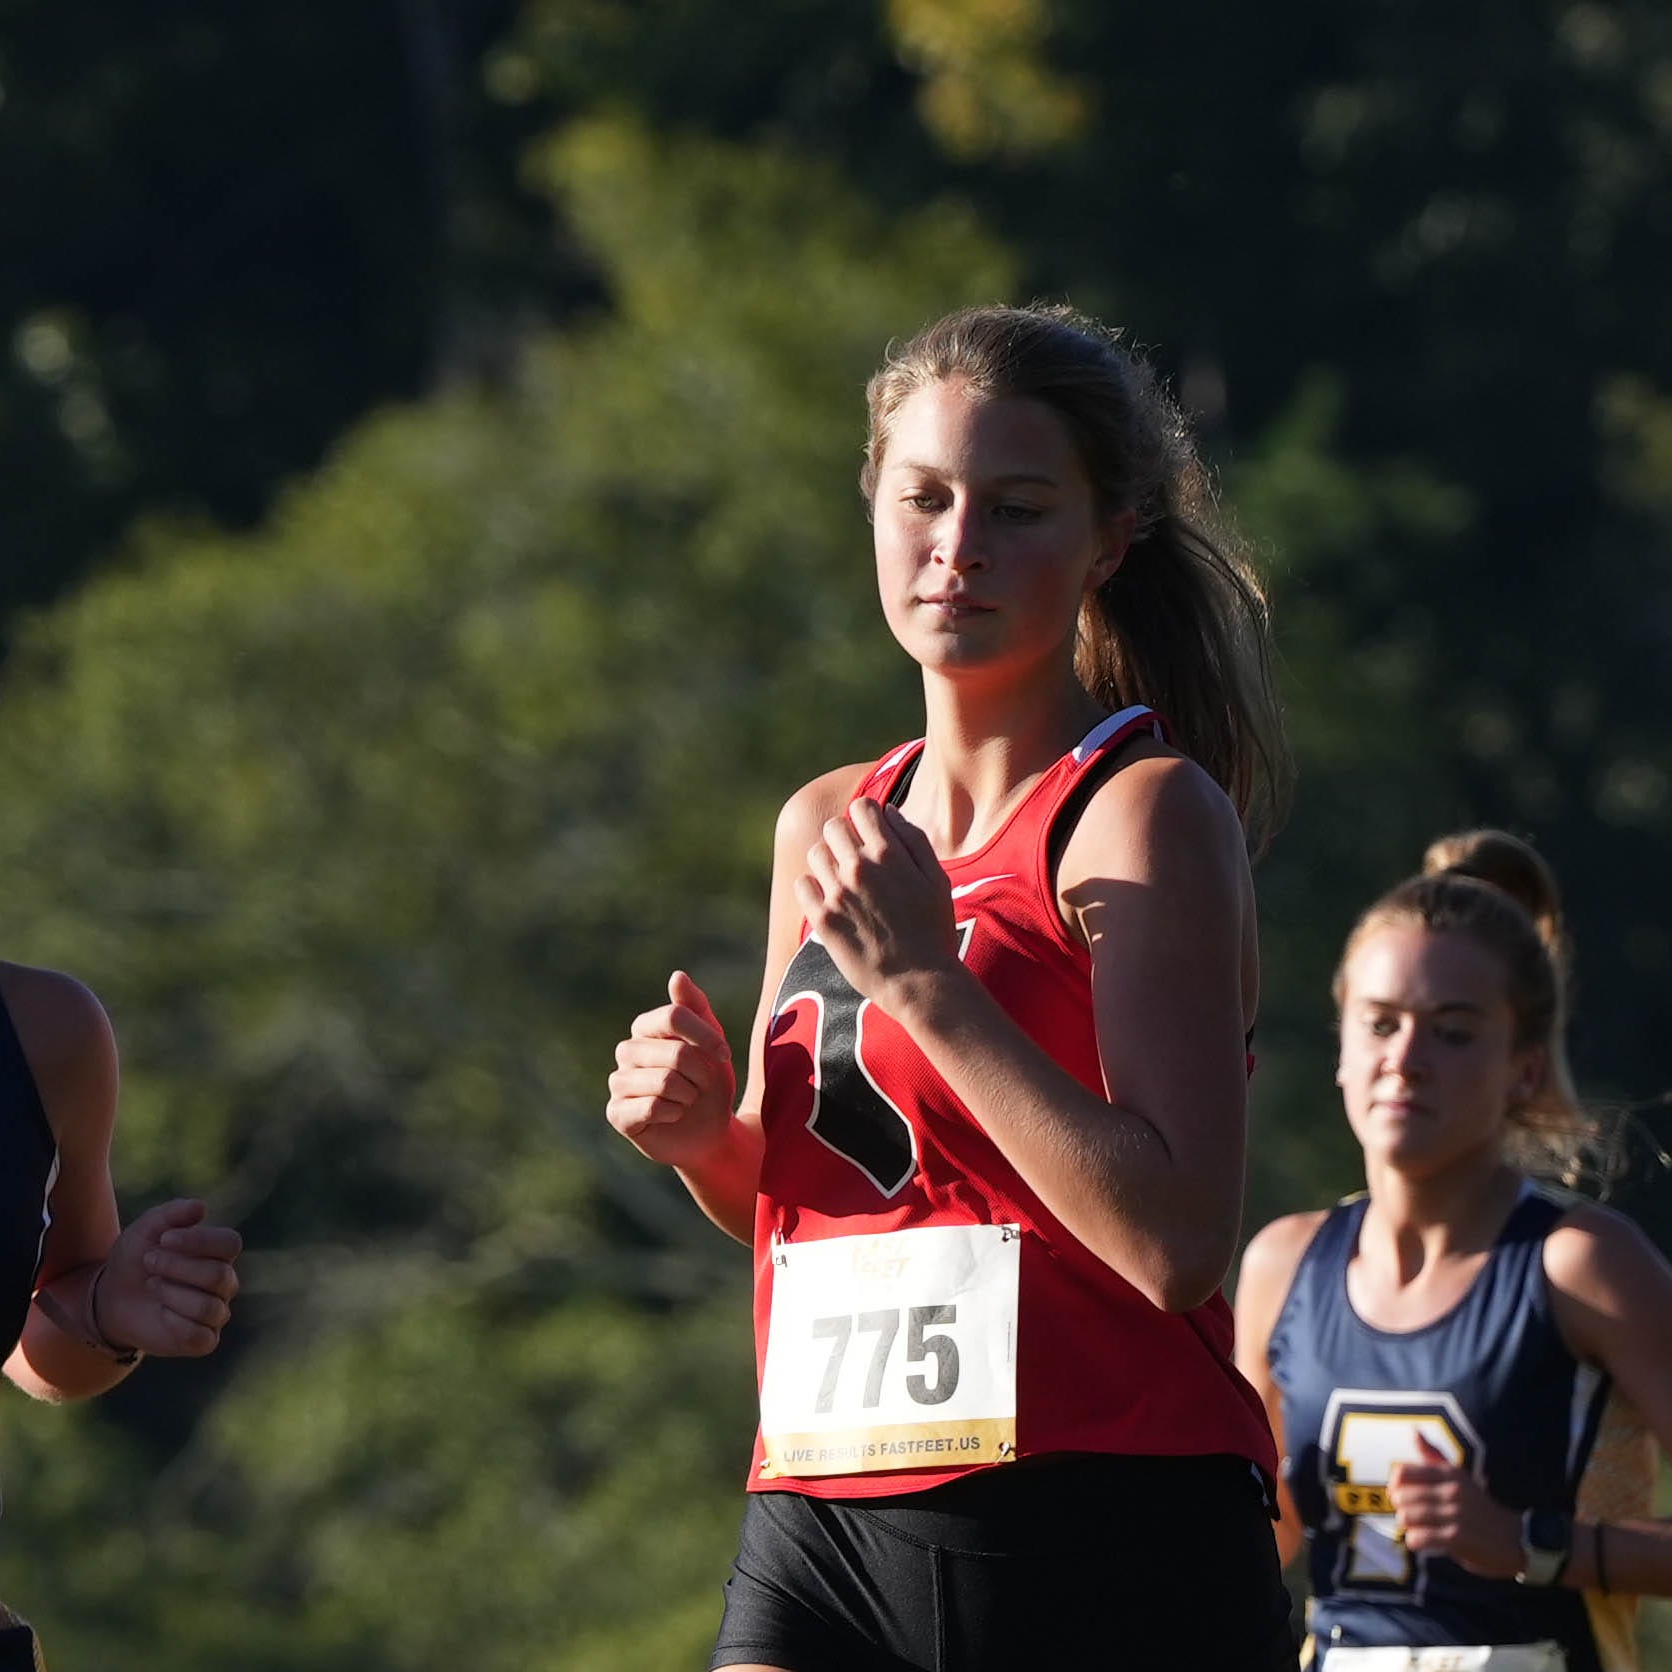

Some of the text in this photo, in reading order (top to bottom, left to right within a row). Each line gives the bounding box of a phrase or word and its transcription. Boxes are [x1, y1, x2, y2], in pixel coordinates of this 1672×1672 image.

[812, 1304, 960, 1414] 775
[784, 1448, 814, 1463] LIVE
[880, 1436, 981, 1456] FASTFEET.US
